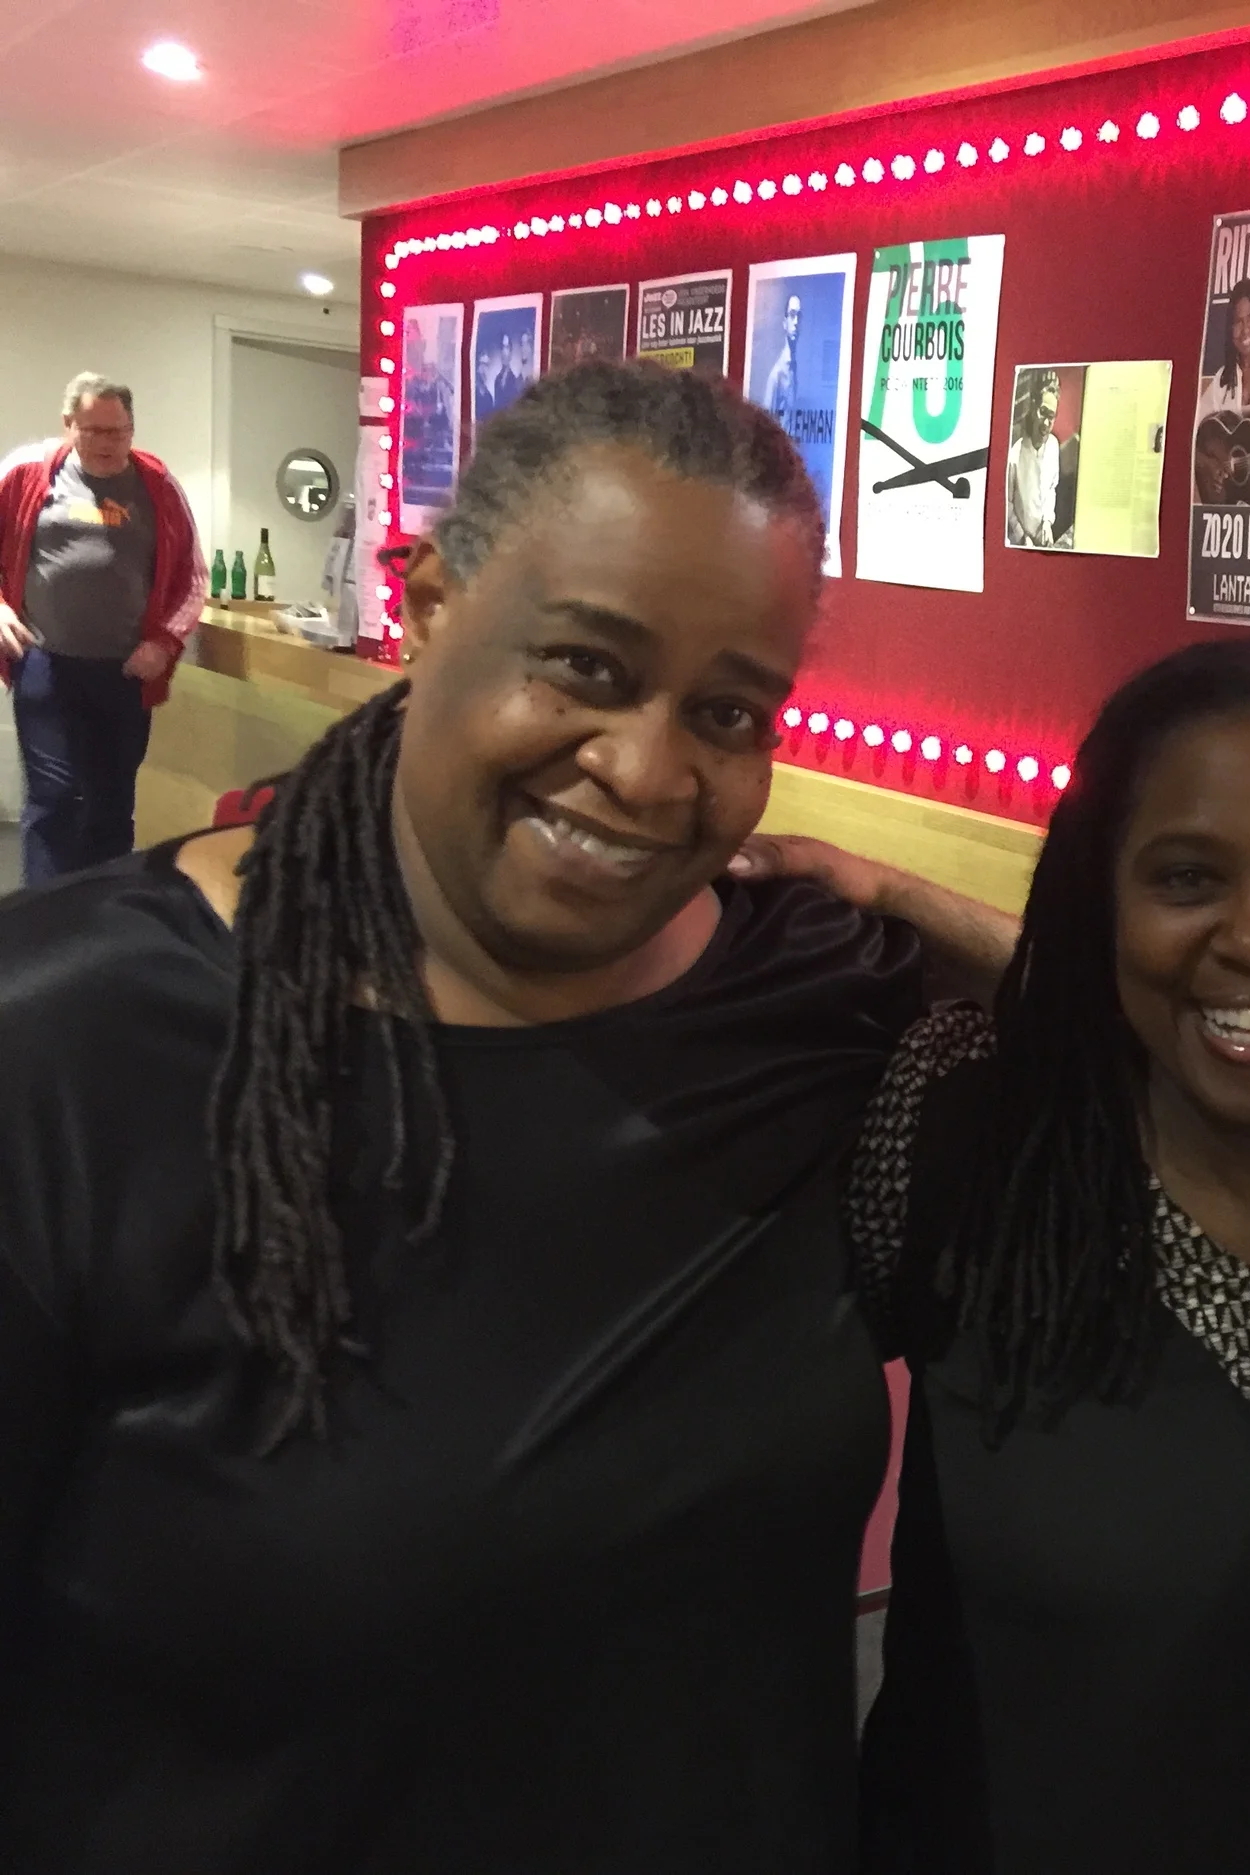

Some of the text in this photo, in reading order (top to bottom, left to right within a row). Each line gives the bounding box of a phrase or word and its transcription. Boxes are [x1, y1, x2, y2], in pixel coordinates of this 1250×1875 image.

[884, 257, 972, 319] PIERRE
[642, 306, 724, 339] LES IN JAZZ
[881, 320, 965, 363] COURBOIS
